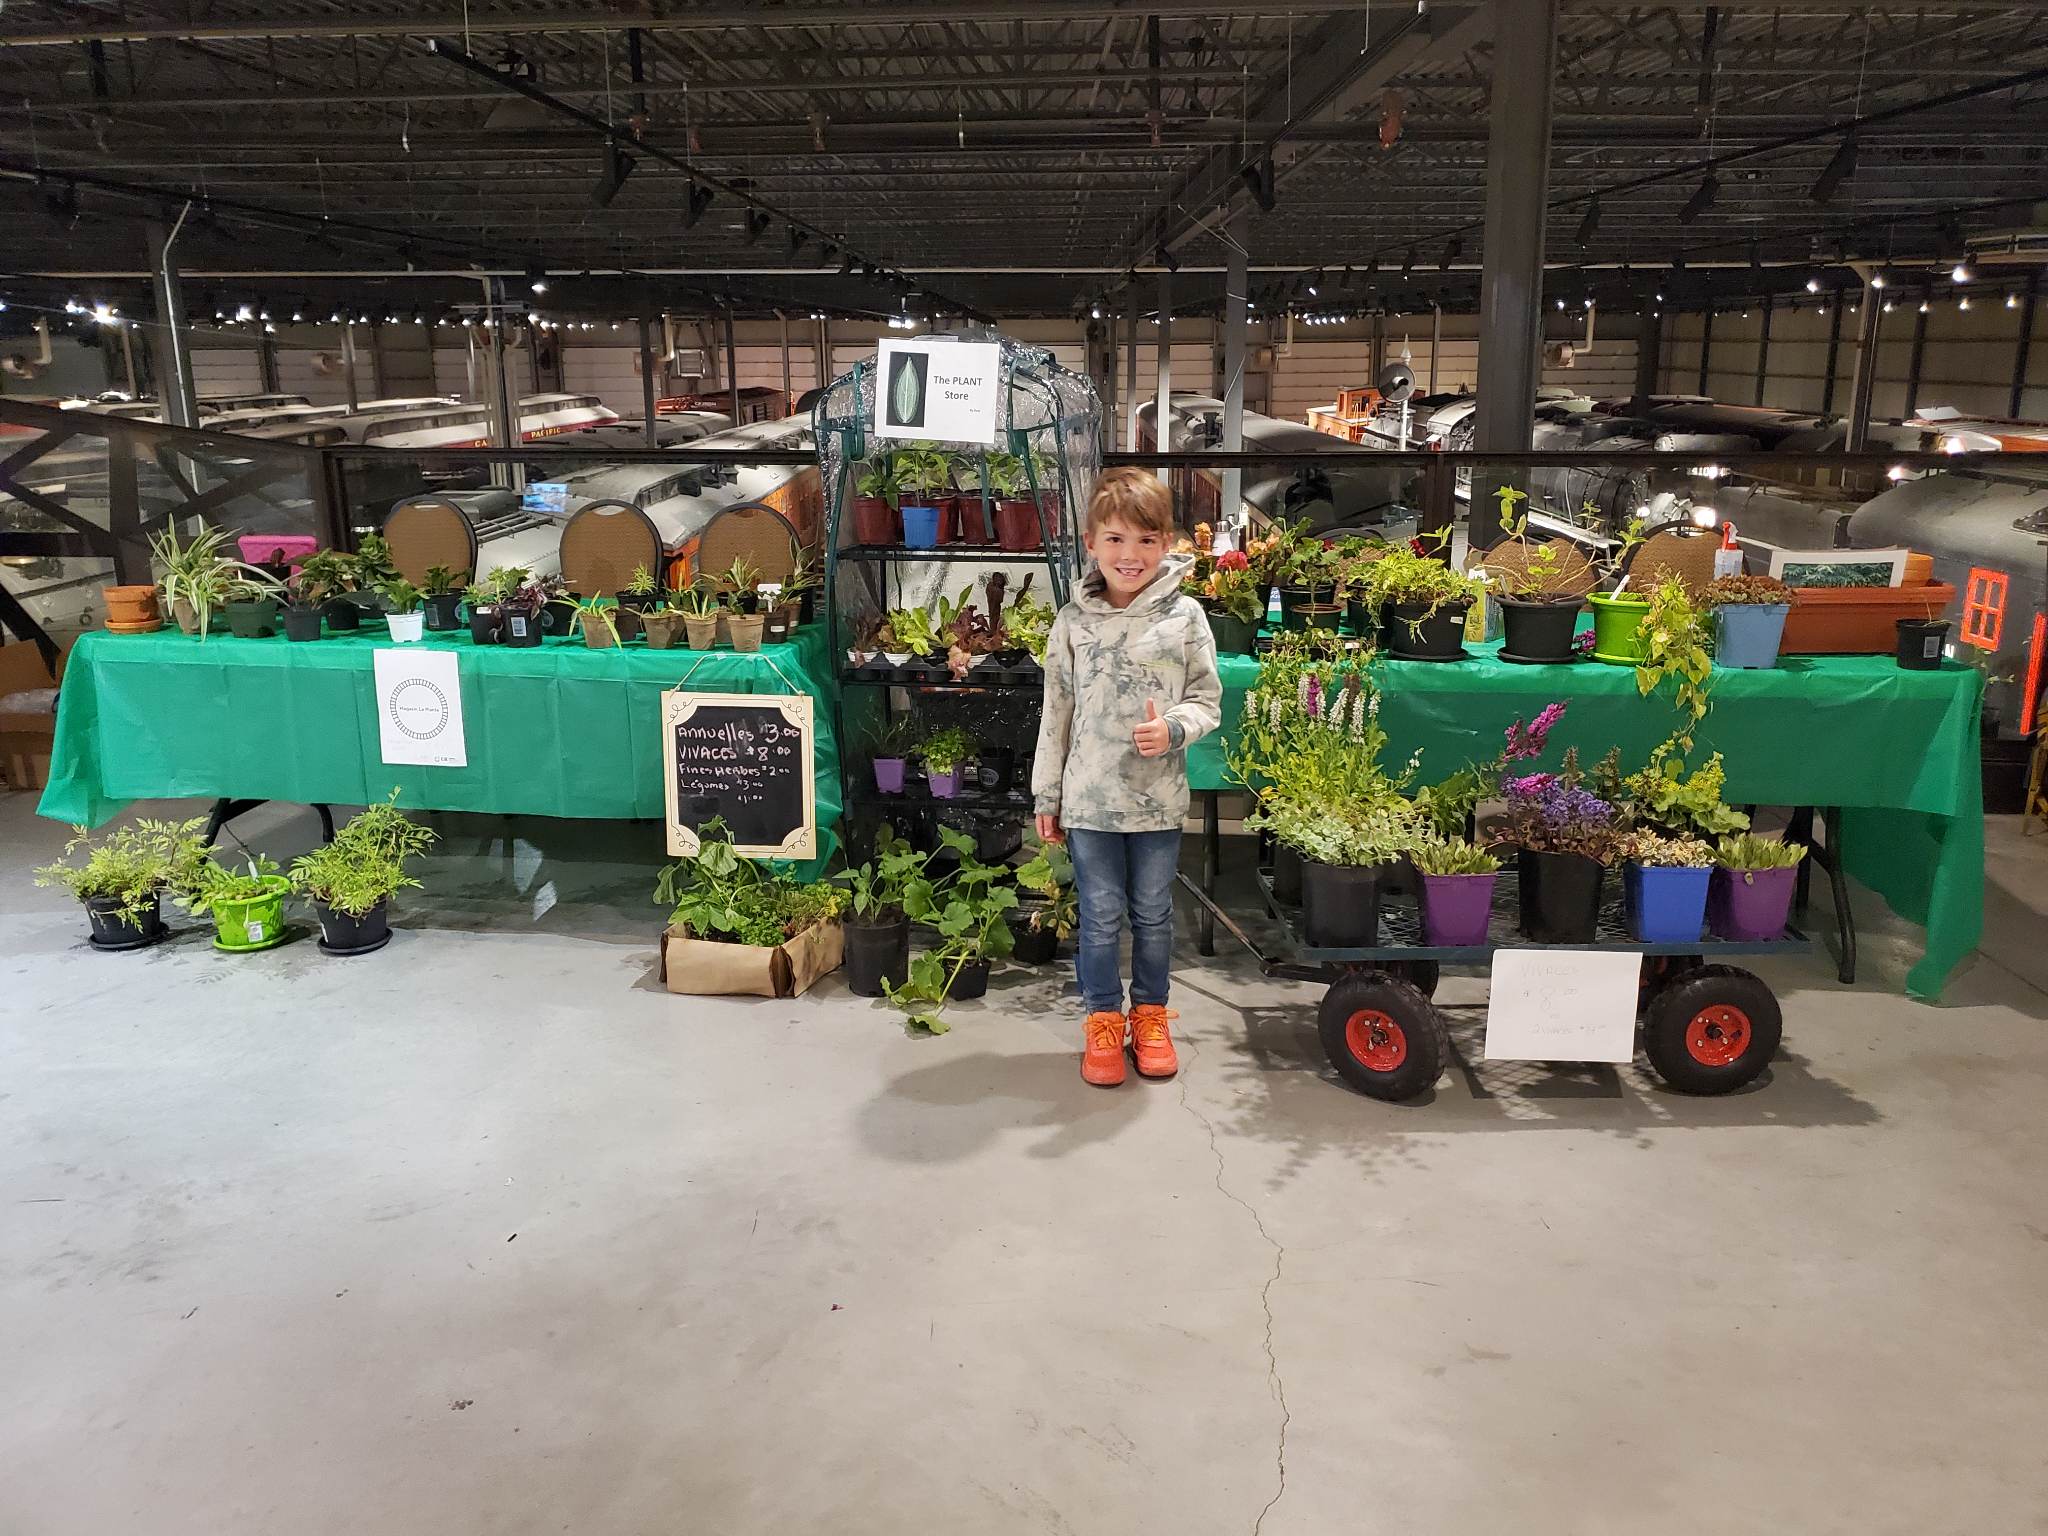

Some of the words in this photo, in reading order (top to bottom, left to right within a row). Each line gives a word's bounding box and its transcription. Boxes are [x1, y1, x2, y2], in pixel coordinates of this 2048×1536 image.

[933, 376, 950, 384] The
[952, 377, 982, 386] PLANT
[944, 391, 969, 400] Store
[531, 428, 560, 438] PACIFIC
[678, 722, 755, 744] Annuelles
[679, 744, 737, 760] VIVACES
